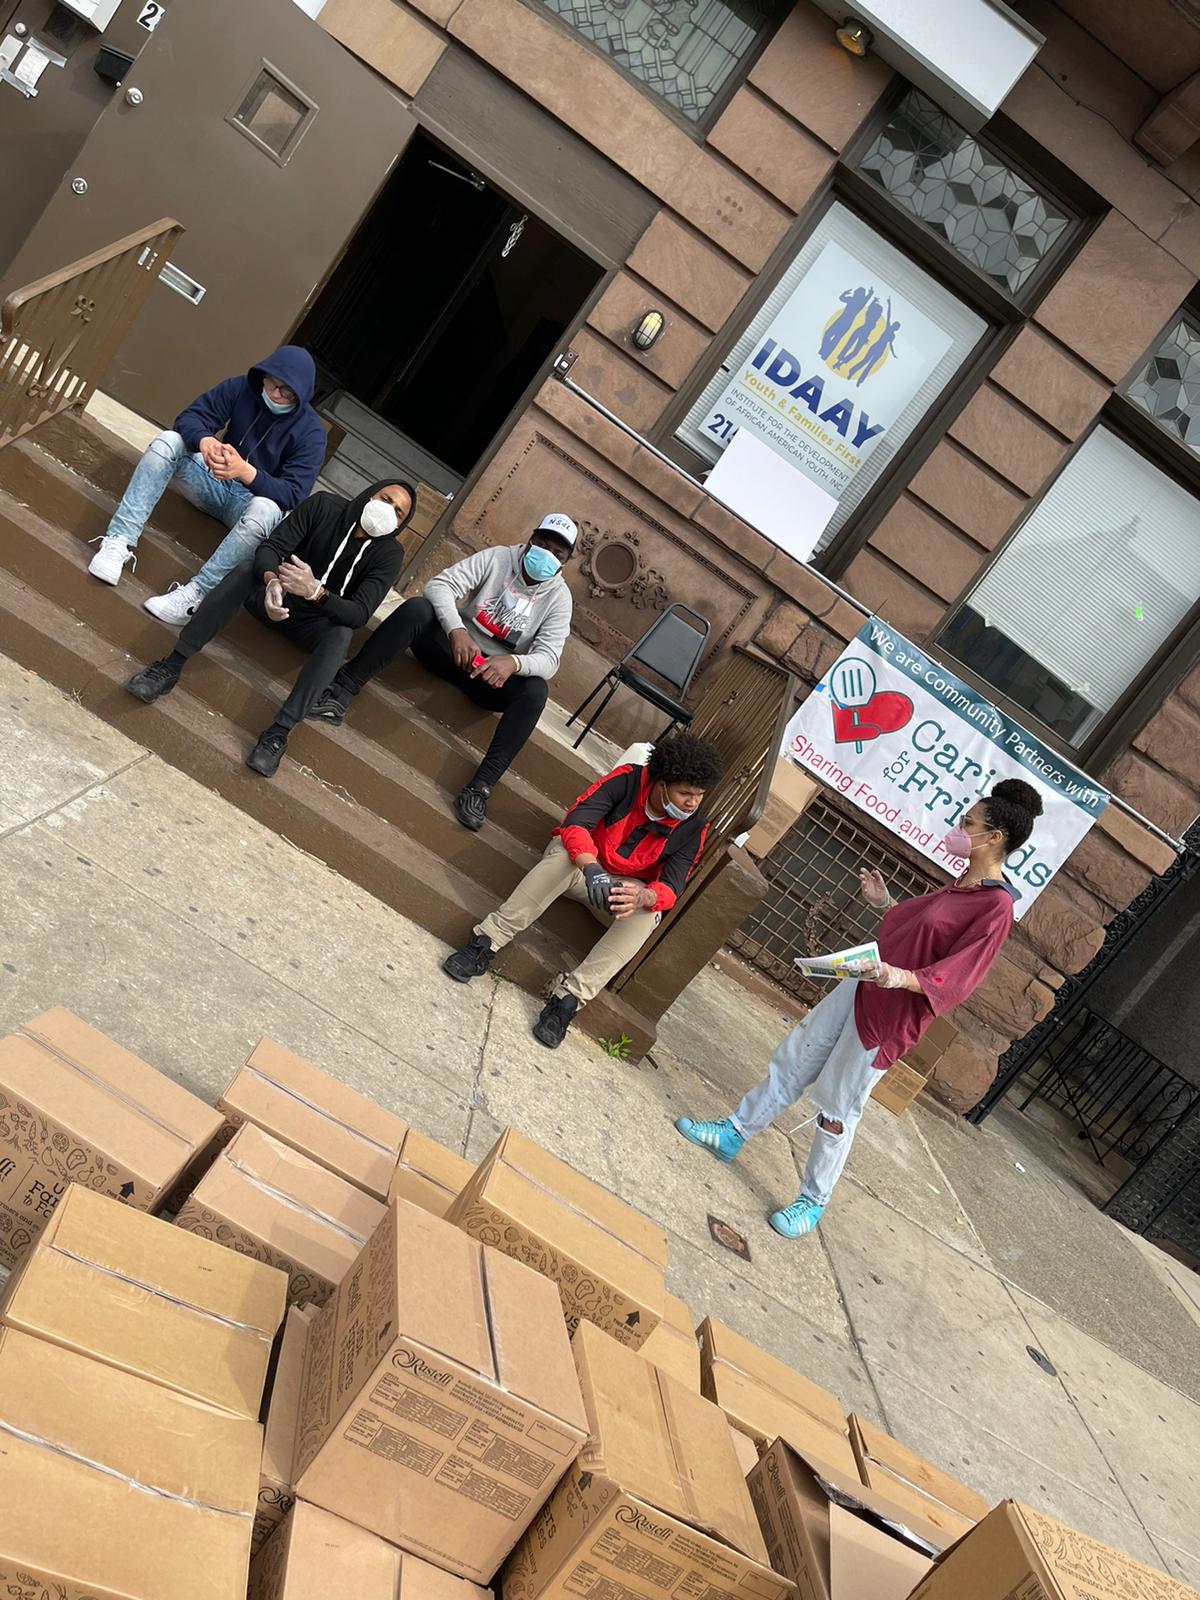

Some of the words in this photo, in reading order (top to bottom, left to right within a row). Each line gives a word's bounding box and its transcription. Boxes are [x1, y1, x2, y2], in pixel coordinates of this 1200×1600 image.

[139, 3, 159, 28] 2
[731, 388, 767, 419] INSTITUTE
[767, 415, 784, 432] FOR
[783, 426, 799, 444] THE
[798, 438, 850, 483] DEVELOPMENT
[743, 370, 777, 402] Youth
[778, 398, 788, 410] &
[787, 405, 834, 447] Families
[835, 442, 862, 468] First
[751, 338, 885, 449] IDAAY
[724, 396, 737, 409] OF
[735, 405, 768, 434] AFRICAN
[766, 429, 805, 461] AMERICAN
[828, 476, 844, 492] INC
[868, 624, 896, 654] We
[895, 648, 923, 676] are
[924, 668, 1006, 739] Community
[1005, 730, 1066, 787] Partners
[1066, 779, 1100, 809] with
[911, 719, 997, 799] Cari
[791, 734, 855, 792] Sharing
[854, 783, 903, 824] Food
[900, 816, 933, 848] and
[882, 750, 912, 783] for
[409, 1354, 454, 1387] Rastelli
